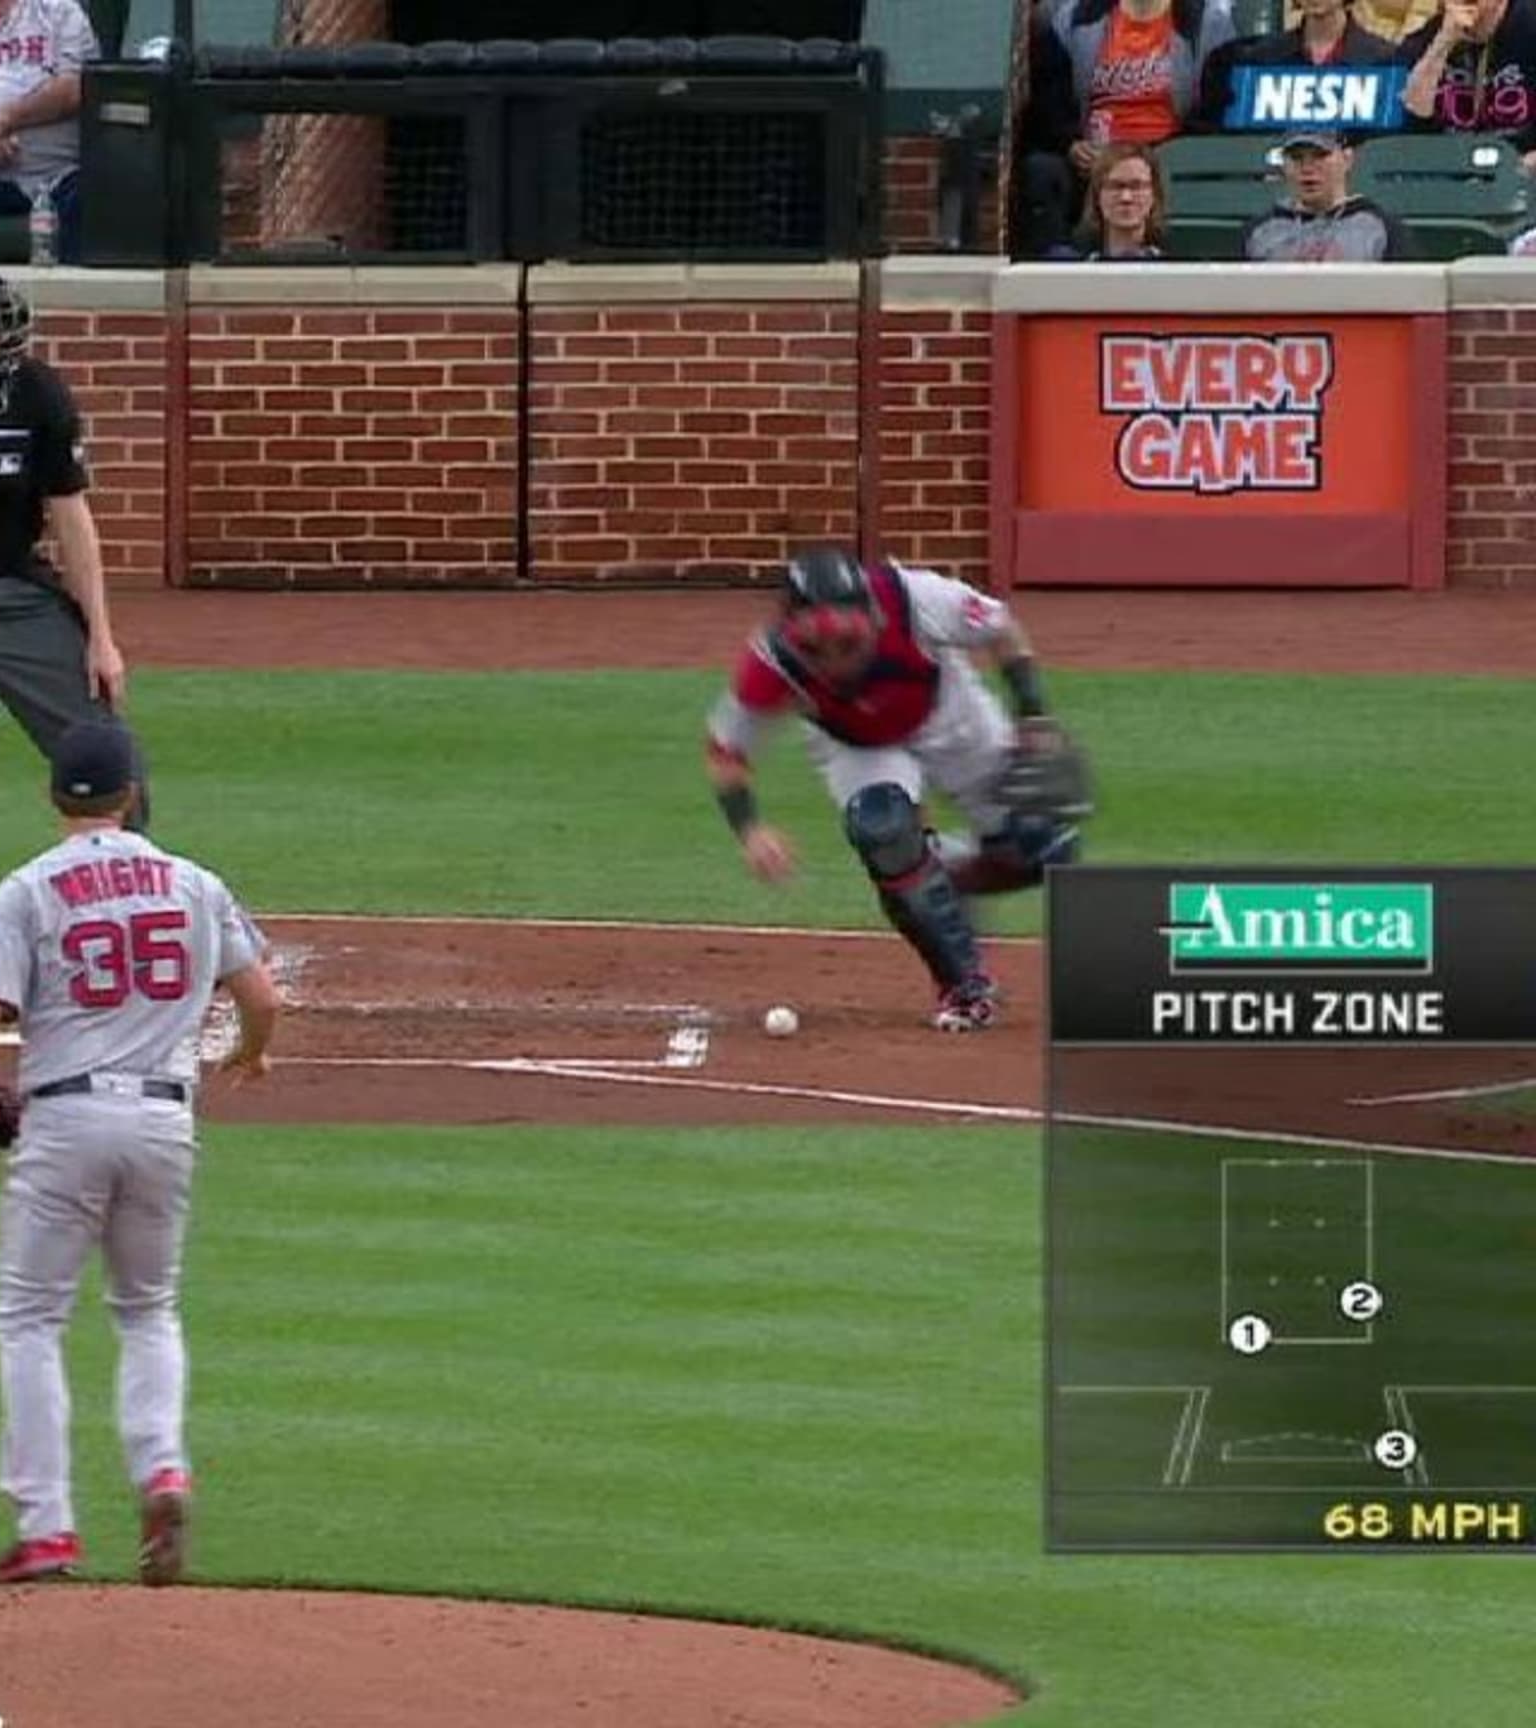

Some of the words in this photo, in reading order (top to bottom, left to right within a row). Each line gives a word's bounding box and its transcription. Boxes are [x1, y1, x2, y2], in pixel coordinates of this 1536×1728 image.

[1102, 336, 1331, 411] EVERY
[1118, 413, 1319, 492] GAME
[49, 855, 172, 908] WRIGHT
[61, 909, 189, 1009] 35
